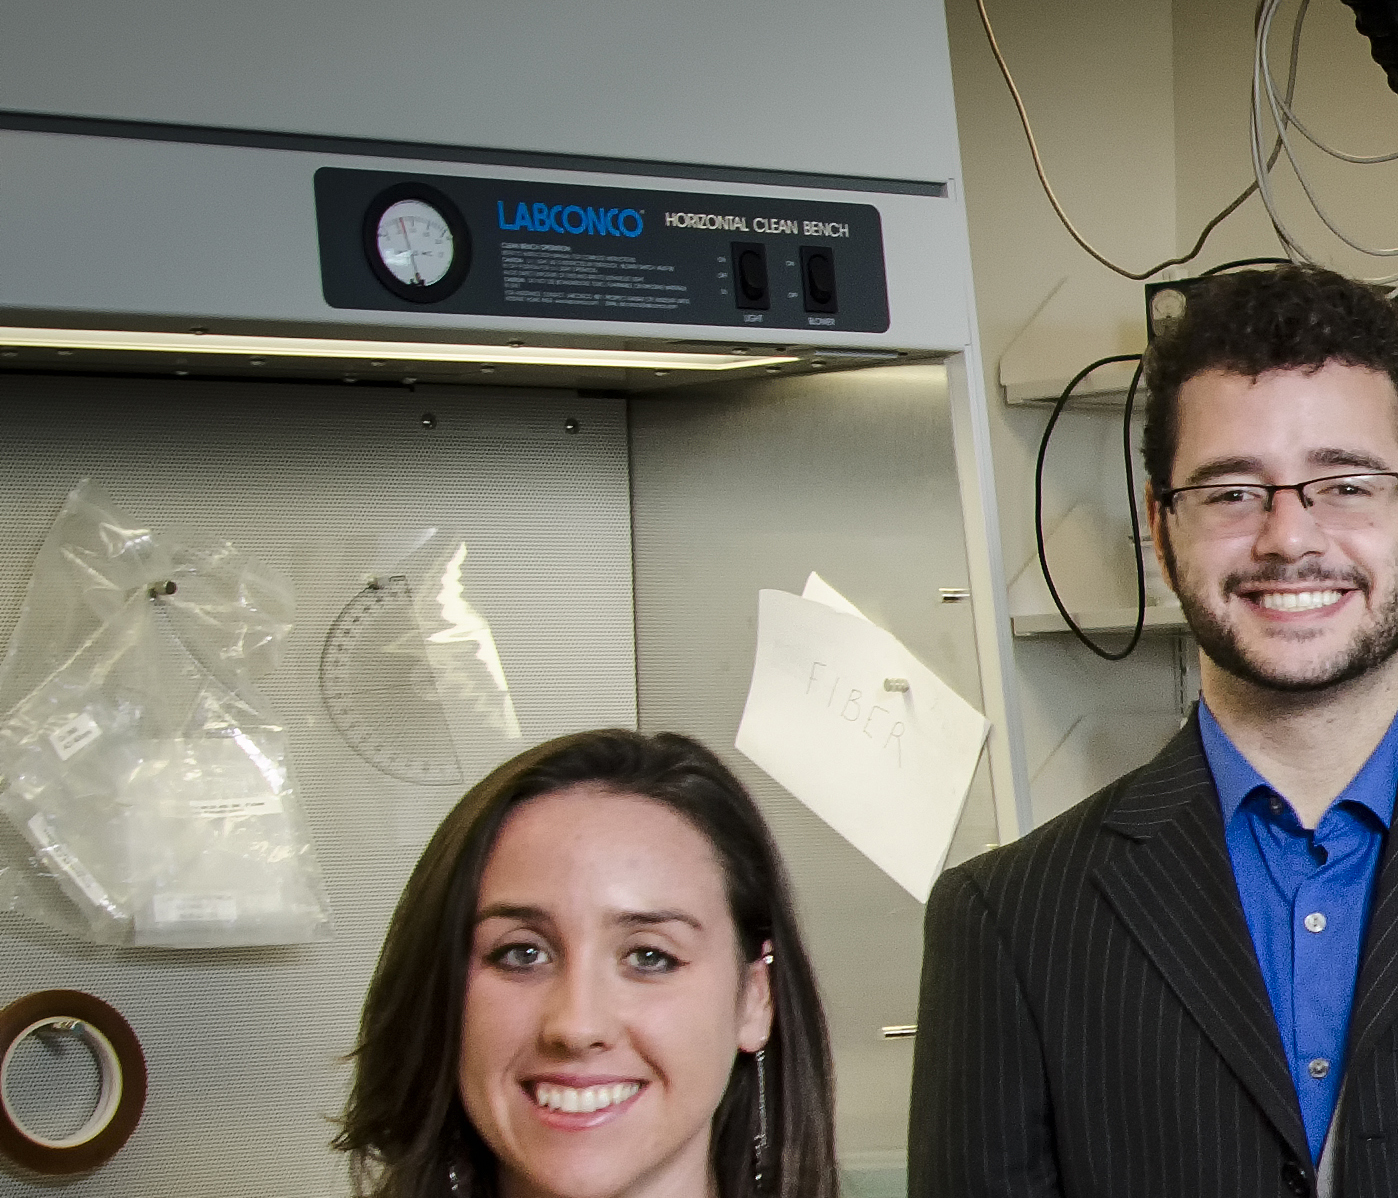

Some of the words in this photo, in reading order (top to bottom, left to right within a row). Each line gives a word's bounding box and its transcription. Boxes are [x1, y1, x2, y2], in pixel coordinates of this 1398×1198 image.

[497, 201, 644, 238] LABCONCO
[665, 212, 750, 232] HORIZONTAL
[753, 218, 799, 235] CLEAN
[803, 221, 850, 238] BENCH
[806, 661, 905, 768] FIBER
